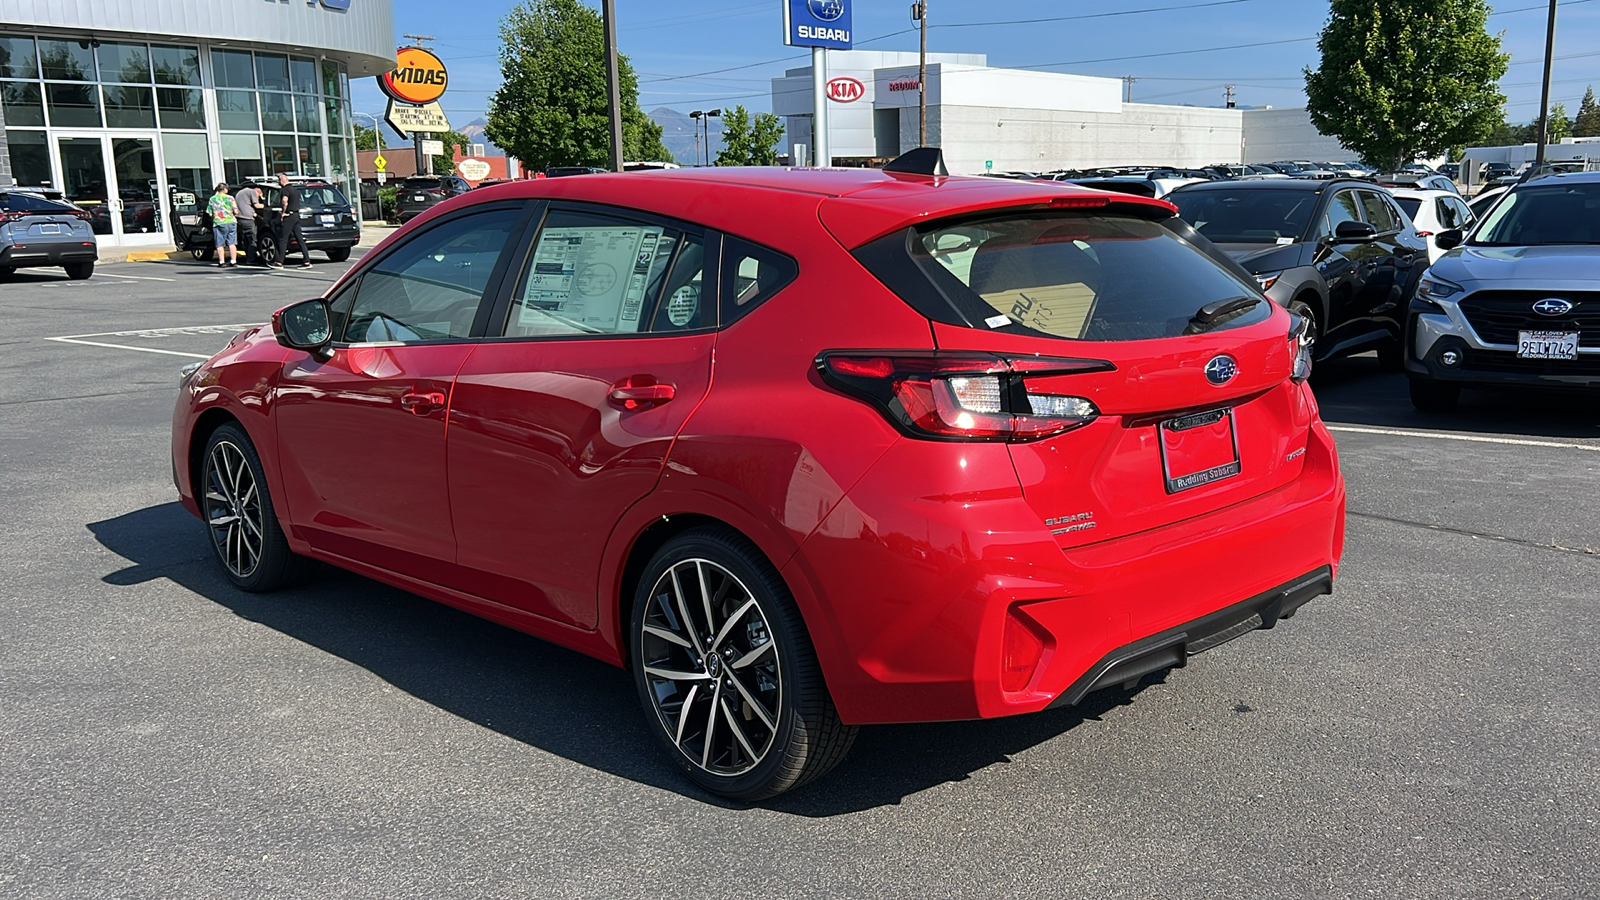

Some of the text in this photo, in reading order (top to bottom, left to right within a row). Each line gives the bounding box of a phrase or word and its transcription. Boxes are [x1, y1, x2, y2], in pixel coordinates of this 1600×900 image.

[798, 26, 850, 42] SUBARU
[391, 66, 446, 85] MIDAS
[830, 83, 858, 97] KIA
[889, 80, 918, 91] REDDIN
[1209, 465, 1235, 478] Subaru
[1045, 511, 1093, 526] SUBARU
